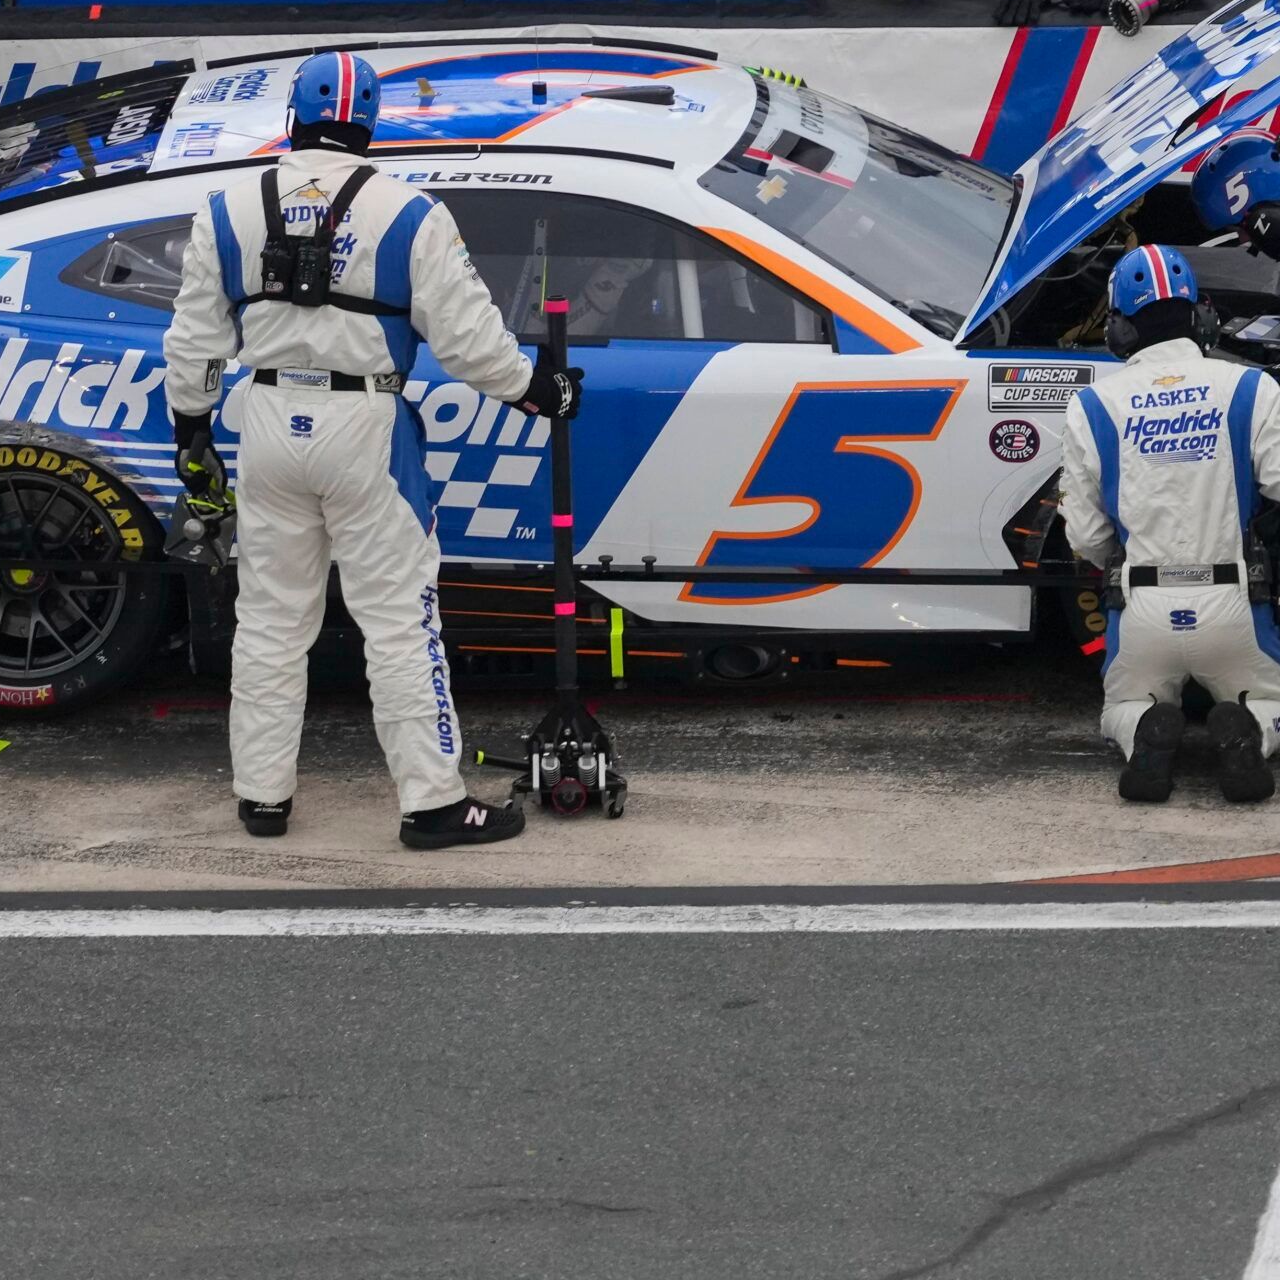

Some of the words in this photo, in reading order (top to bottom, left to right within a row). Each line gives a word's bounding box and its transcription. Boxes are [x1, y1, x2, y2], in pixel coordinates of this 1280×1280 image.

[231, 67, 280, 103] Hendrick
[106, 104, 156, 147] LARSON
[1224, 171, 1252, 217] 5
[282, 204, 352, 225] UDWG
[1021, 367, 1079, 383] NASCAR
[1003, 388, 1031, 402] CUP
[1031, 388, 1078, 402] SERIES
[1130, 385, 1211, 410] CASKEY
[995, 423, 1033, 439] NASCAR
[1123, 407, 1224, 446] Hendrick
[995, 445, 1034, 460] SALUTES
[1139, 433, 1218, 455] Cars.com
[675, 377, 970, 607] 5
[515, 526, 537, 540] TM
[463, 805, 488, 827] N
